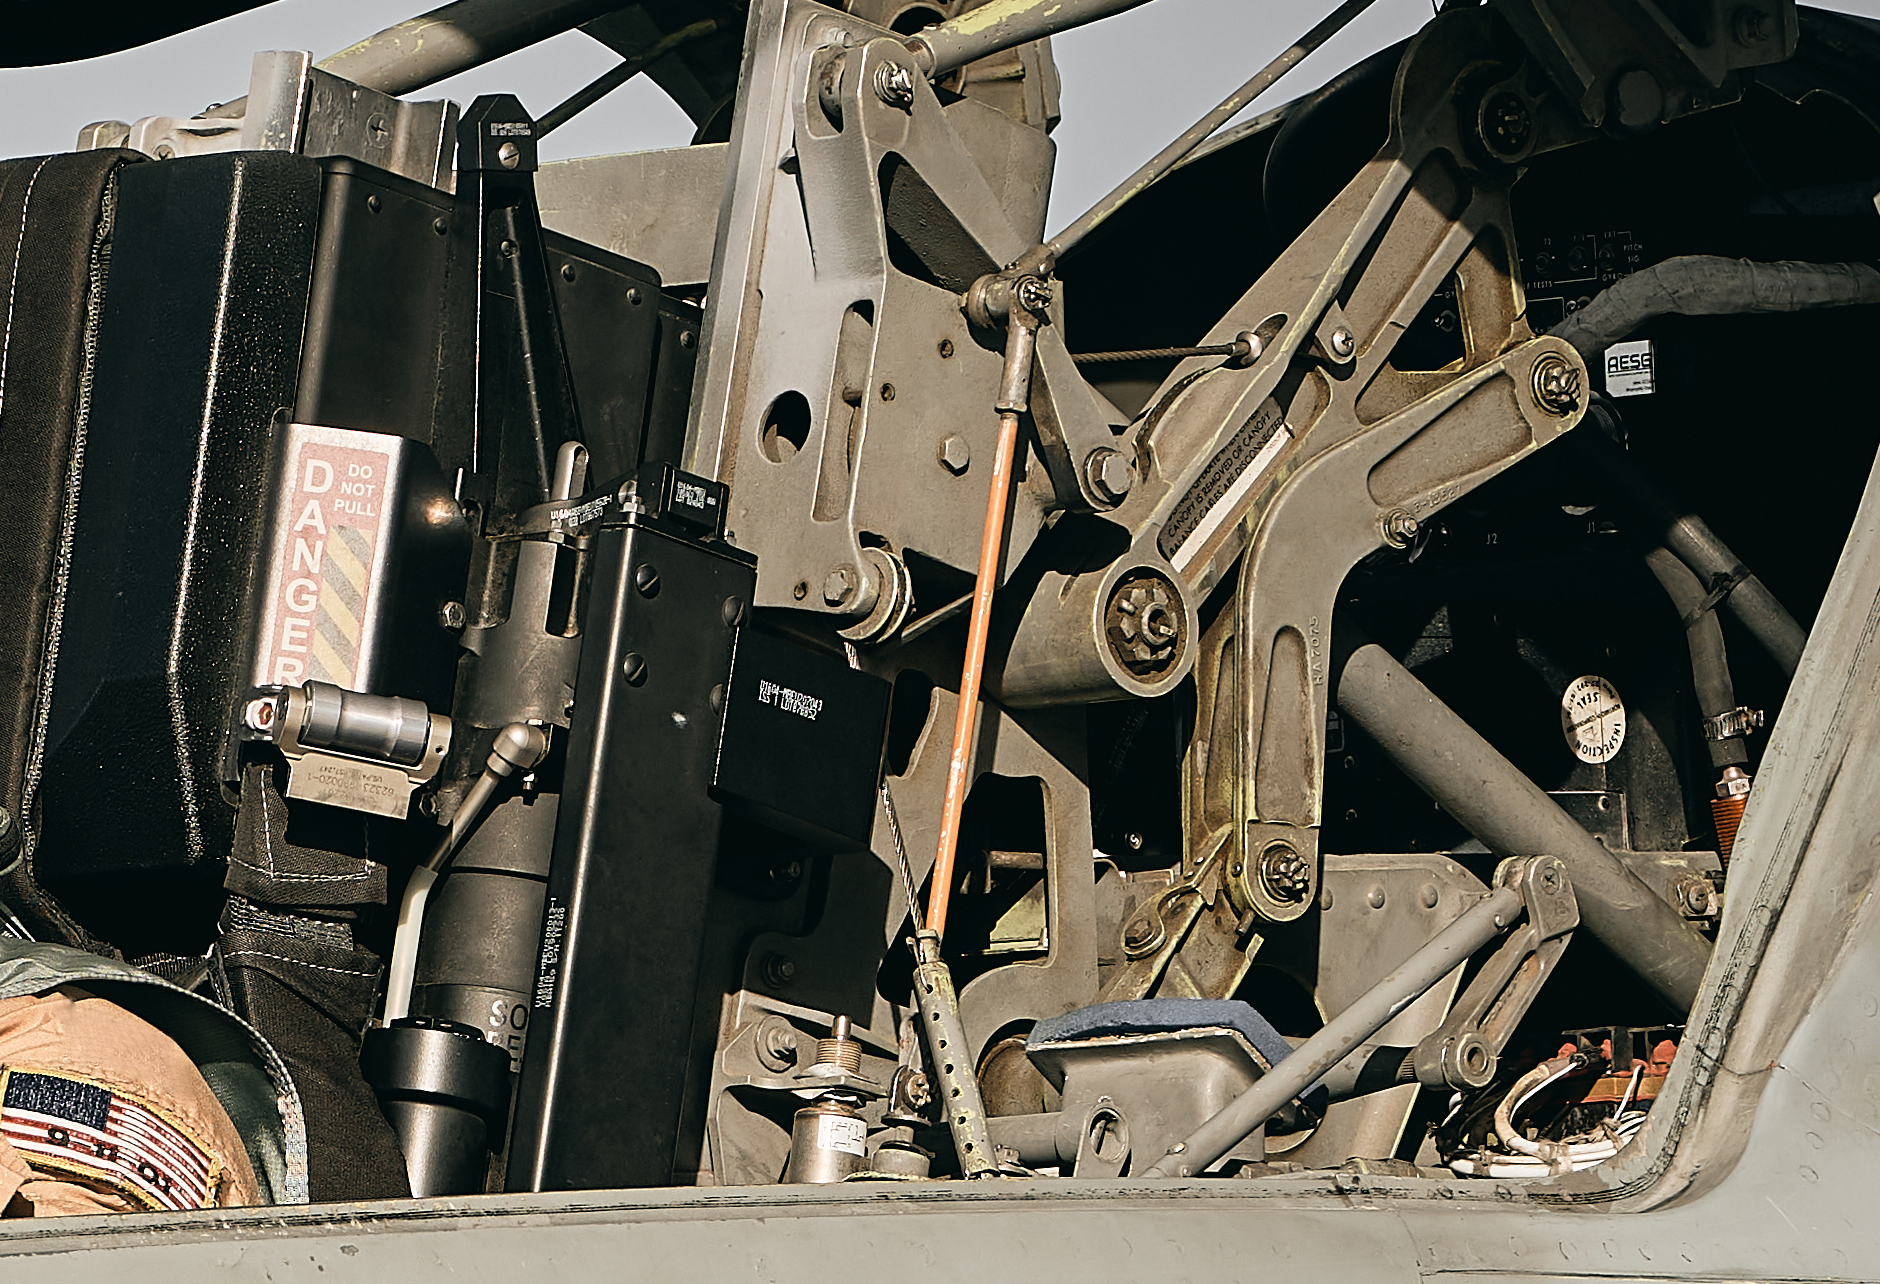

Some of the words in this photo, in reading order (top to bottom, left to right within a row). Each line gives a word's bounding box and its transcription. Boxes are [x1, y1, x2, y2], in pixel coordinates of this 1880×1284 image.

[348, 463, 373, 479] DO
[1168, 501, 1196, 538] CANOPY
[1196, 492, 1204, 504] IS
[1202, 457, 1234, 497] REMOVED
[1232, 444, 1245, 459] OR
[1242, 410, 1271, 448] CANOPY
[341, 482, 376, 498] NOT
[333, 498, 376, 517] PULL
[1586, 521, 1596, 534] J1
[1486, 532, 1498, 545] J2
[274, 458, 334, 688] DANGER
[1576, 691, 1600, 709] SEAL
[1575, 723, 1622, 757] INSPECTION
[363, 782, 395, 796] 62323
